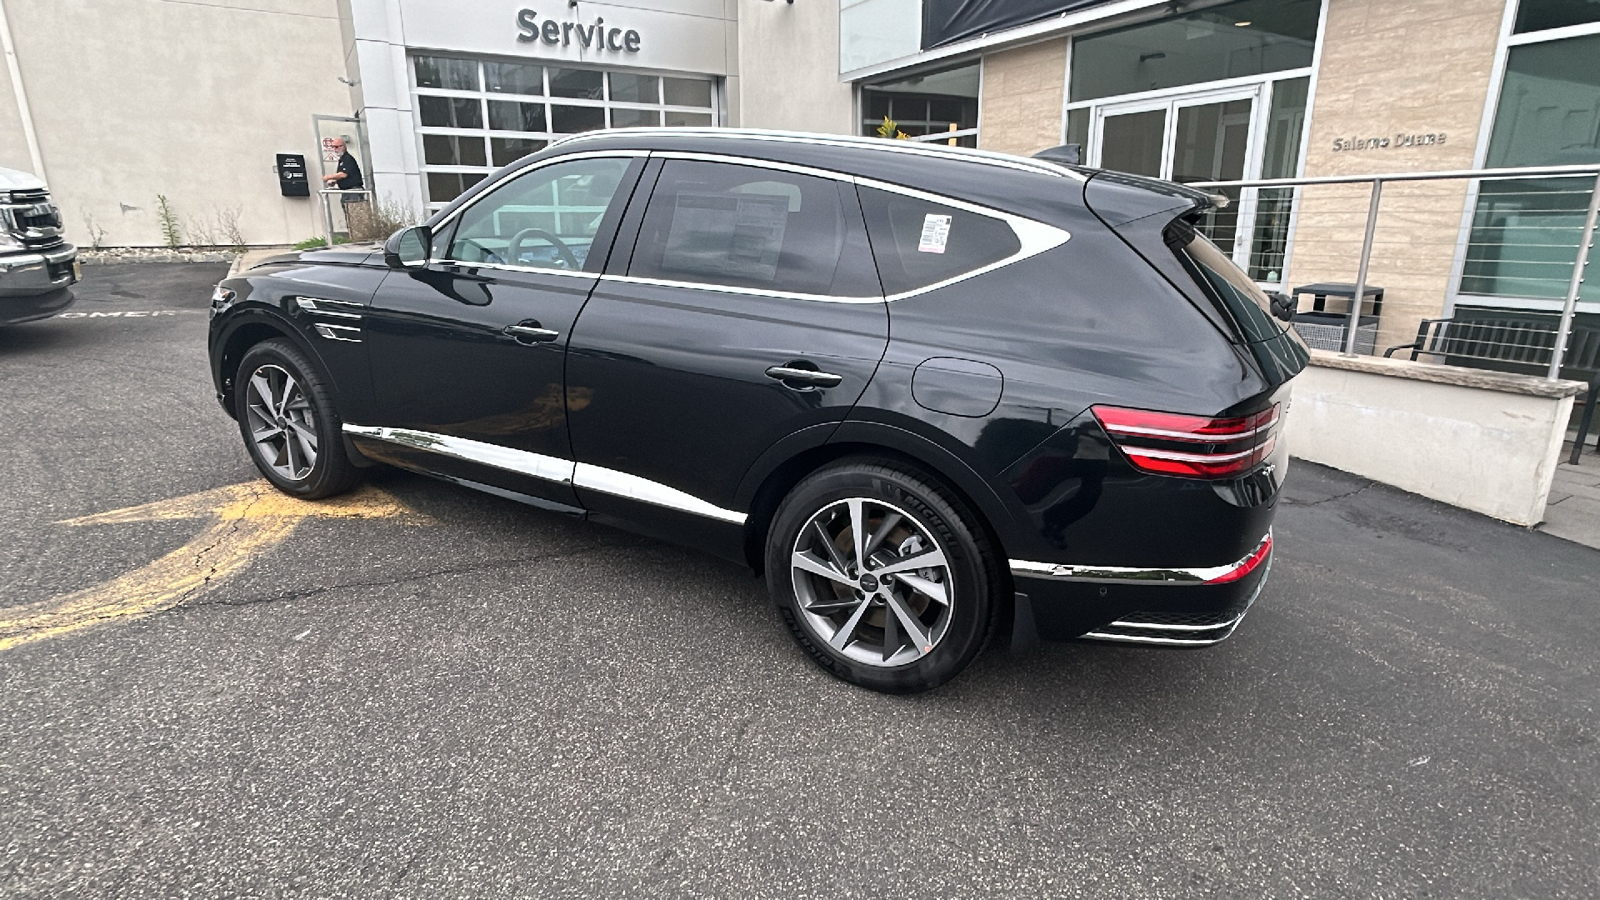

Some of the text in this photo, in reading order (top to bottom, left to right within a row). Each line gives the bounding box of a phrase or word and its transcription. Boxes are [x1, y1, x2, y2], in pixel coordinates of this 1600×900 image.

[516, 8, 641, 53] Service
[1332, 133, 1448, 152] Salerno Duane
[904, 495, 960, 556] MICHELI
